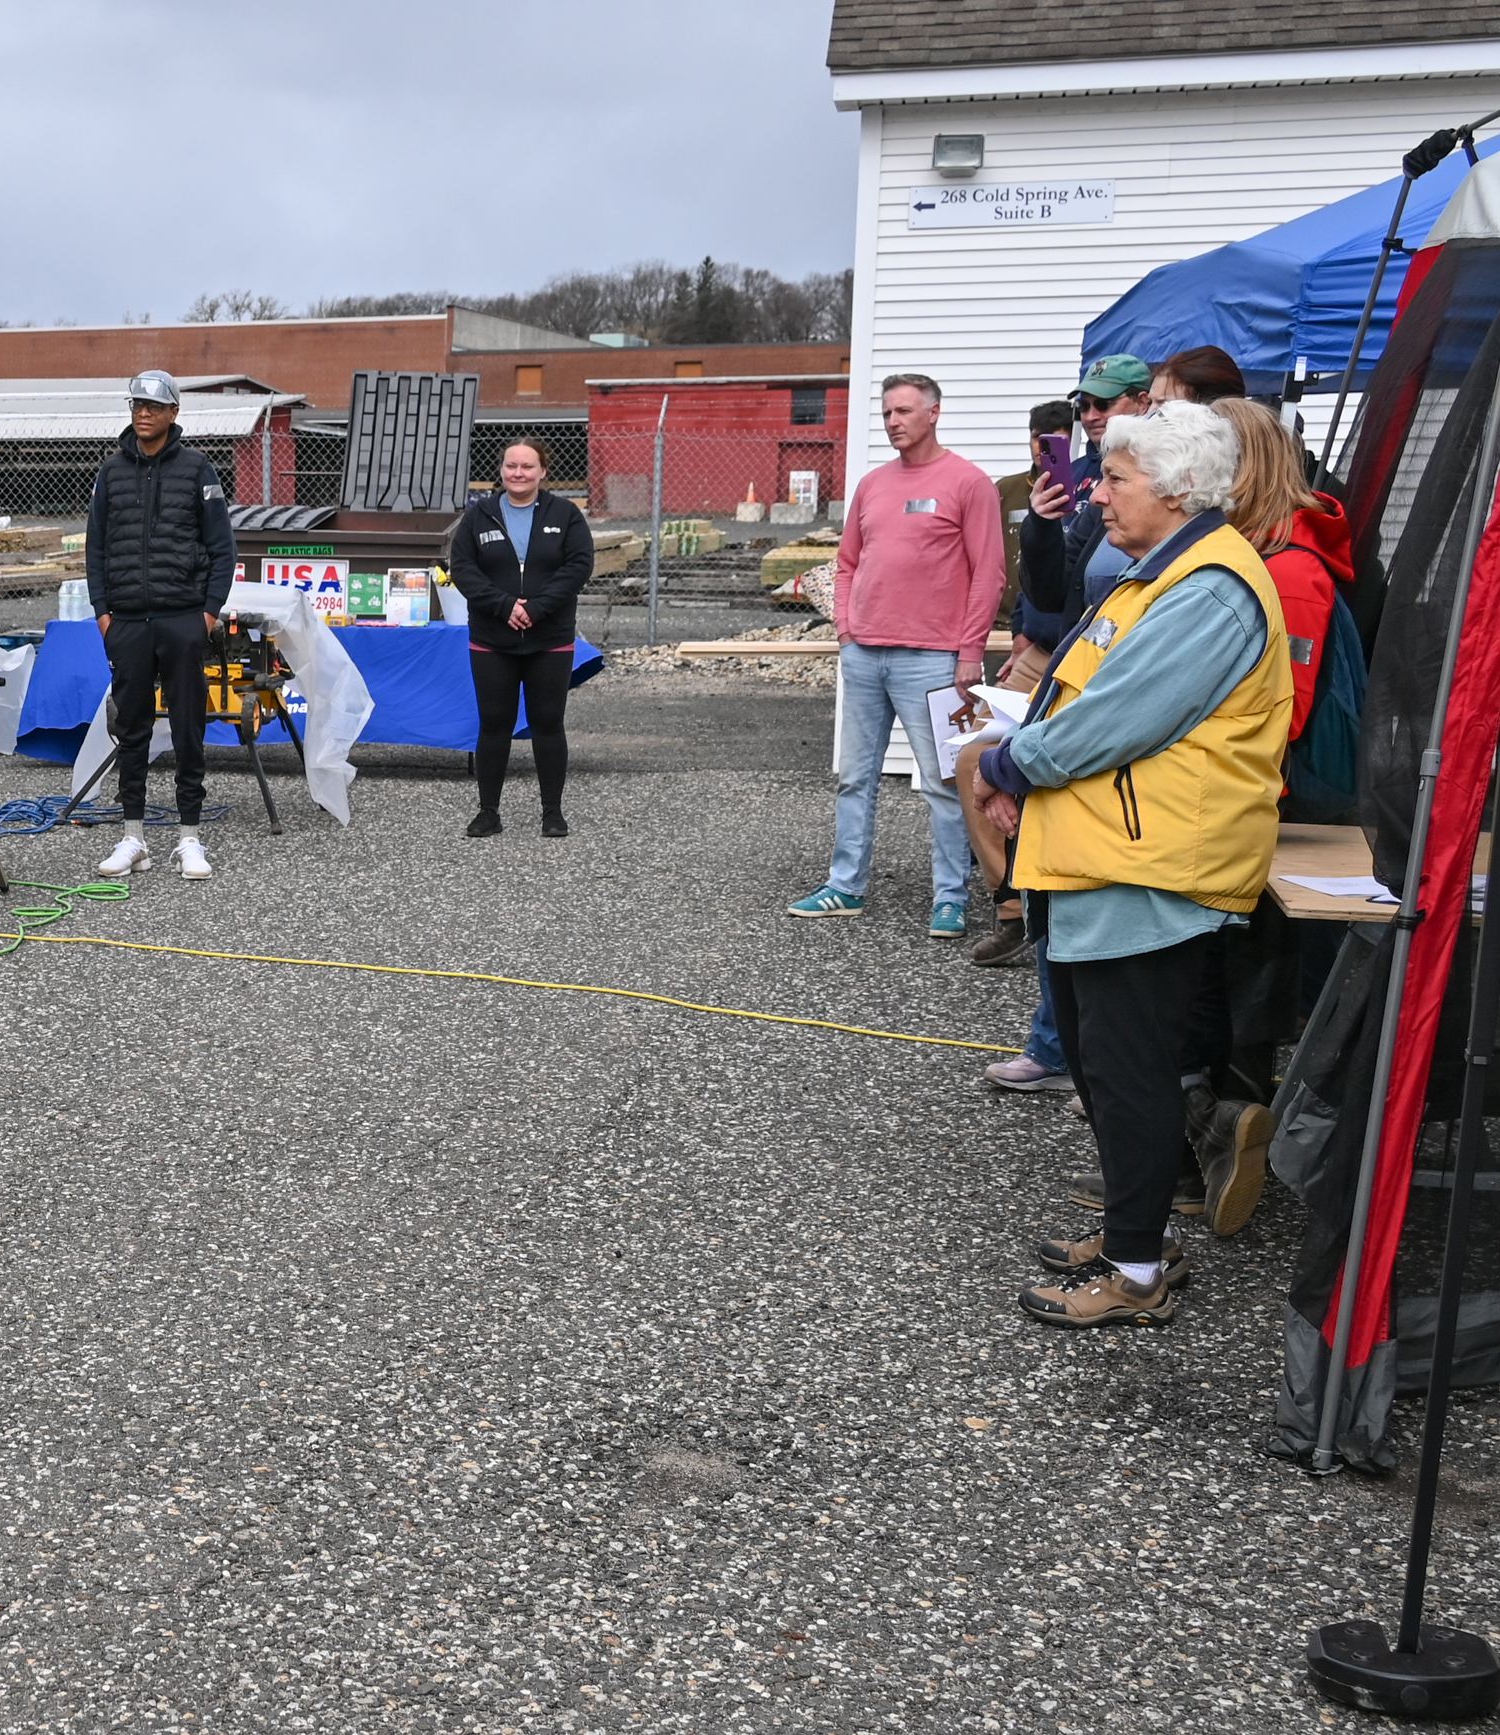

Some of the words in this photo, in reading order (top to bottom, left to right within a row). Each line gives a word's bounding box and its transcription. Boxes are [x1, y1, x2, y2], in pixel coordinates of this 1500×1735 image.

[940, 189, 967, 204] 268
[973, 188, 1010, 203] Cold
[1015, 186, 1069, 206] Spring
[1074, 185, 1108, 200] Ave.
[994, 205, 1034, 220] Suite
[1040, 204, 1052, 219] B
[269, 547, 280, 555] NO
[281, 547, 312, 555] PLASTIC
[313, 546, 333, 555] BAGS
[267, 564, 343, 593] USA
[307, 596, 343, 610] -2984
